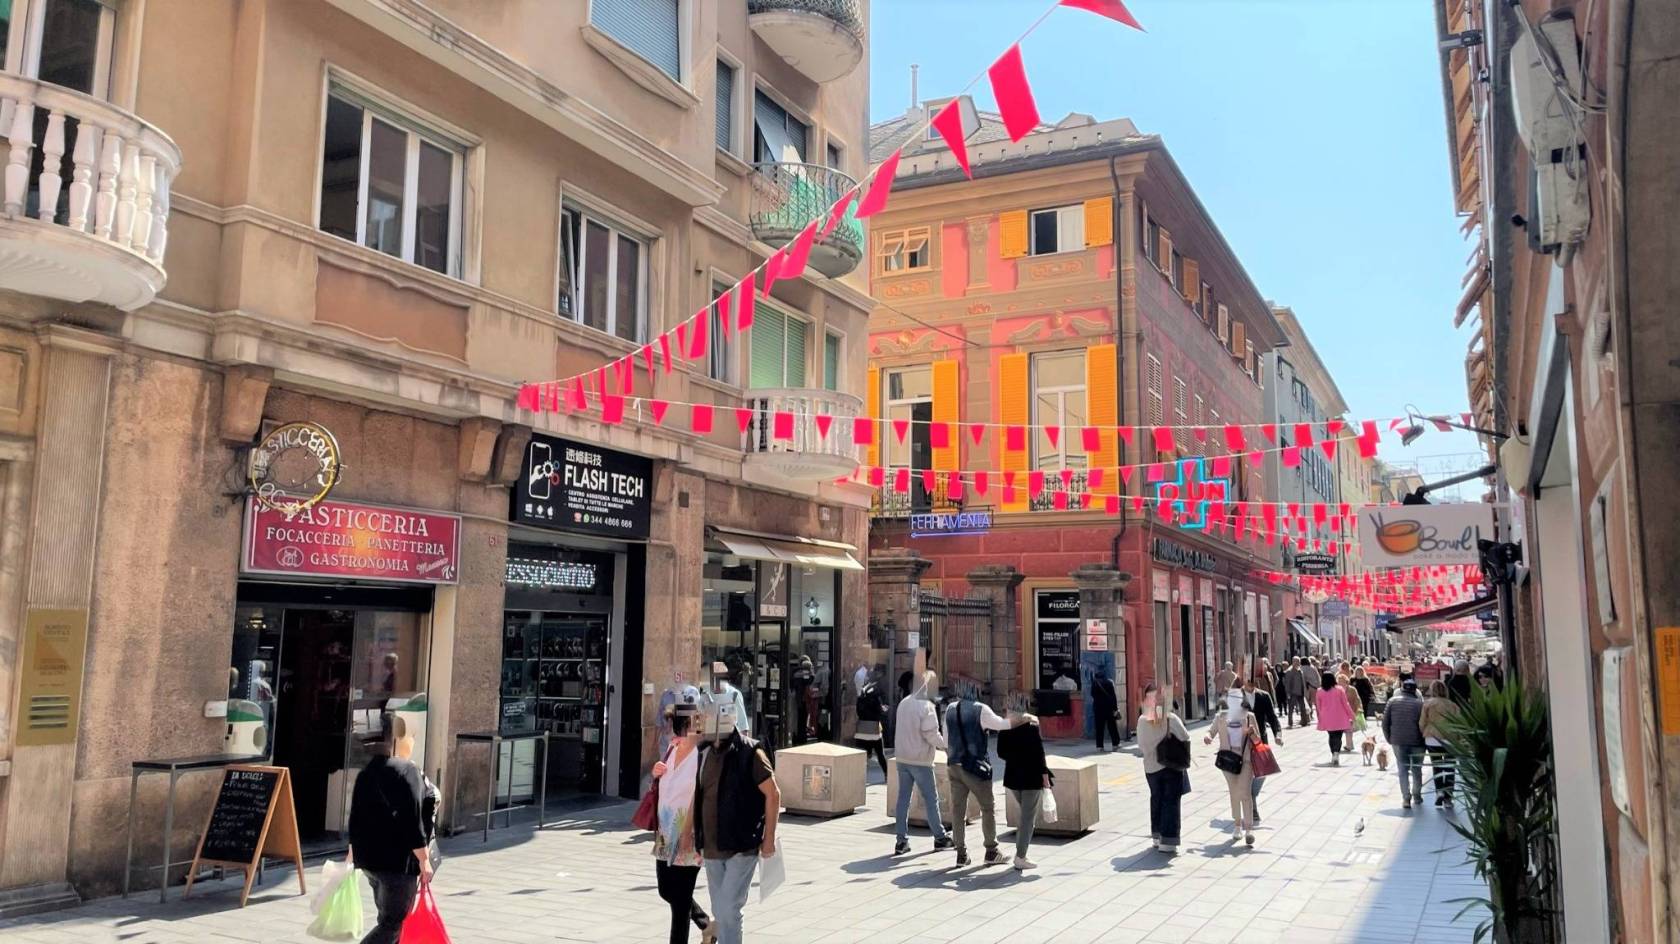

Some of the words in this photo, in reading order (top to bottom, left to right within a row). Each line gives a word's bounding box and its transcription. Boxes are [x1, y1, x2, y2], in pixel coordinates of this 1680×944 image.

[564, 464, 608, 492] FLASH
[611, 472, 644, 498] TECH
[284, 502, 429, 537] PASTICCERIA
[911, 512, 991, 530] FERRAMENTA
[266, 527, 355, 548] FOCACCERIA
[367, 537, 446, 556] PANETTERIA
[1418, 525, 1472, 552] Bowl
[310, 552, 409, 572] GASTRONOMIA
[1296, 555, 1334, 563] RISTORANTE
